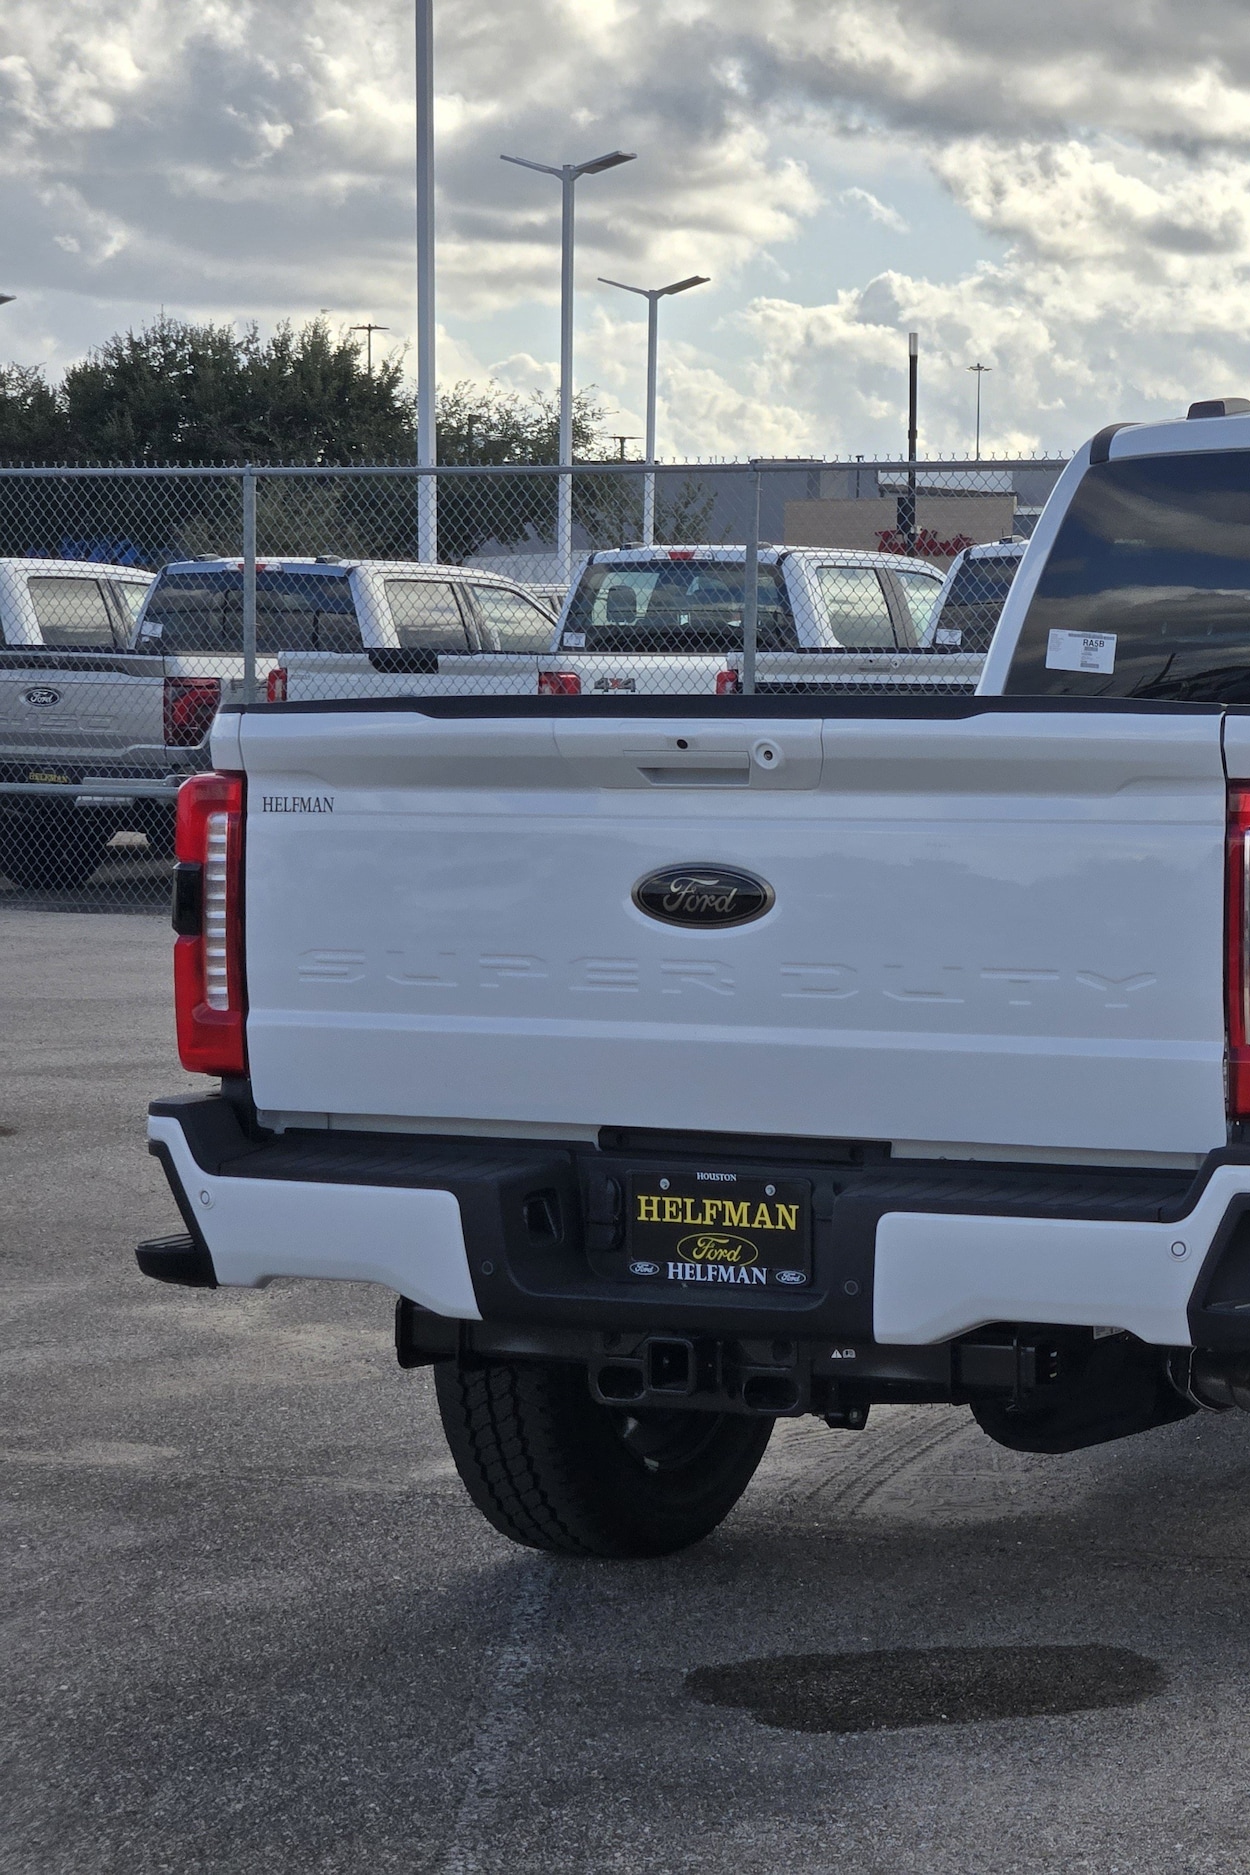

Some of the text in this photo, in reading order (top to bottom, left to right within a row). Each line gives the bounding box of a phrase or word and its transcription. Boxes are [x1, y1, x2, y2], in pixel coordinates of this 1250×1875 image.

[1082, 639, 1105, 647] RA5B
[30, 691, 54, 703] Ford
[262, 796, 335, 813] HELFMAN
[662, 876, 738, 914] Ford
[298, 949, 1157, 1009] SUPER DUTY
[697, 1172, 737, 1182] HOUSTON
[637, 1195, 799, 1231] HELFMAN
[692, 1236, 742, 1263] Ford
[667, 1262, 767, 1285] HELFMAN
